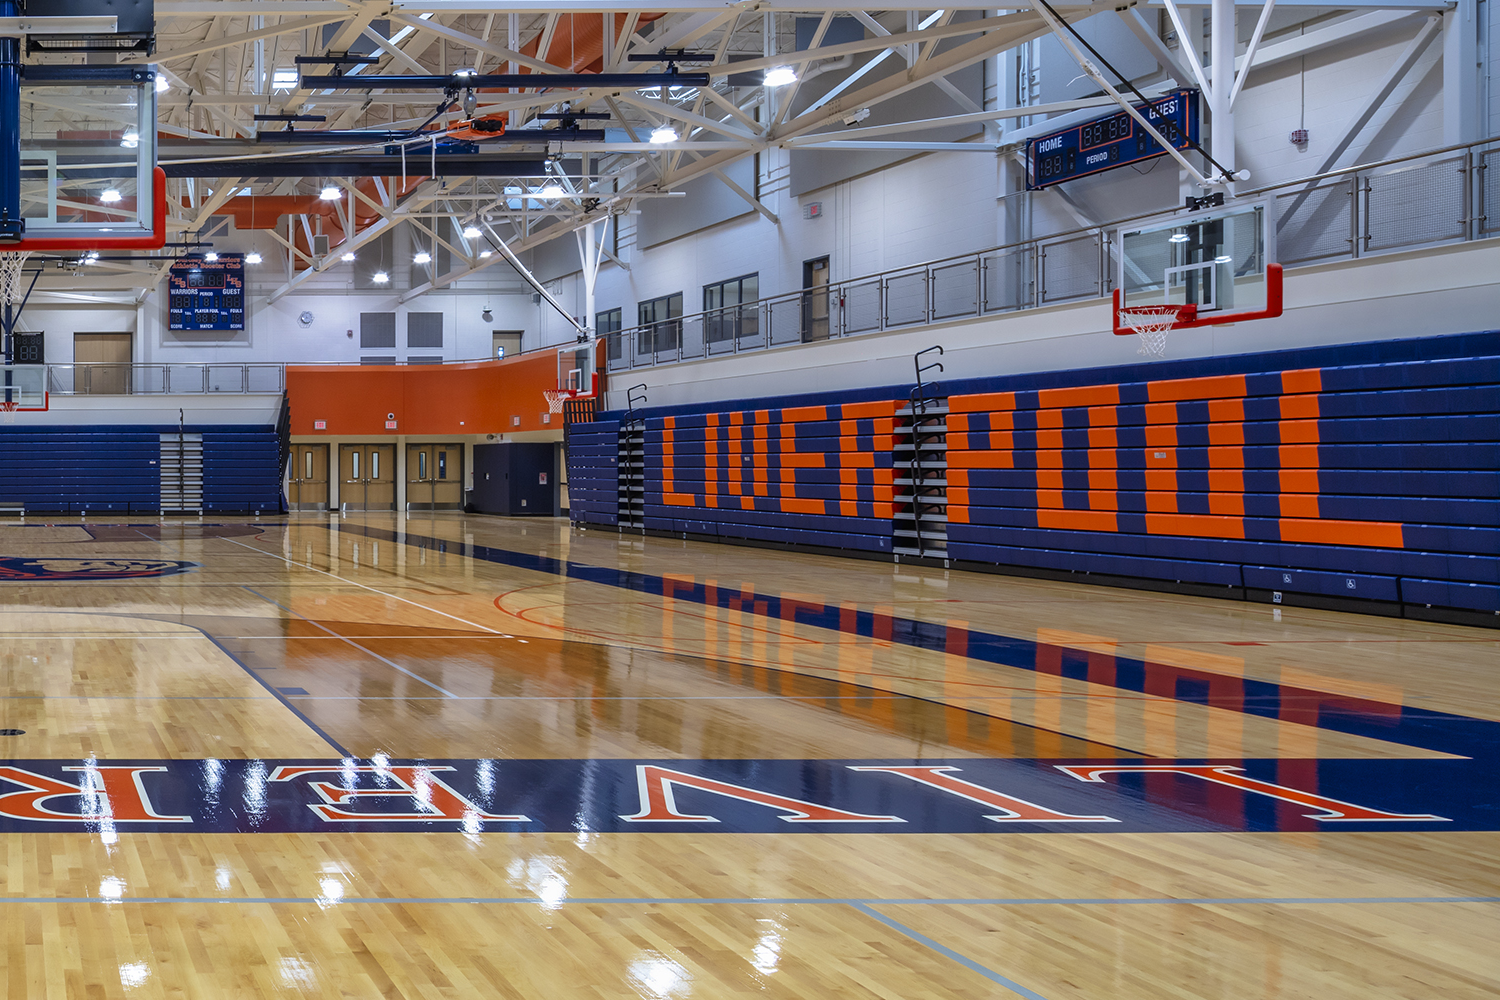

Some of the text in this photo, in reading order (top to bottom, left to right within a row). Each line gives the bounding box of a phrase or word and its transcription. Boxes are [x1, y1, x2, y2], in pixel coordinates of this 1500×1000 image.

[1149, 100, 1179, 120] GUEST
[1039, 136, 1063, 153] HOME
[1086, 151, 1108, 165] PERIOD
